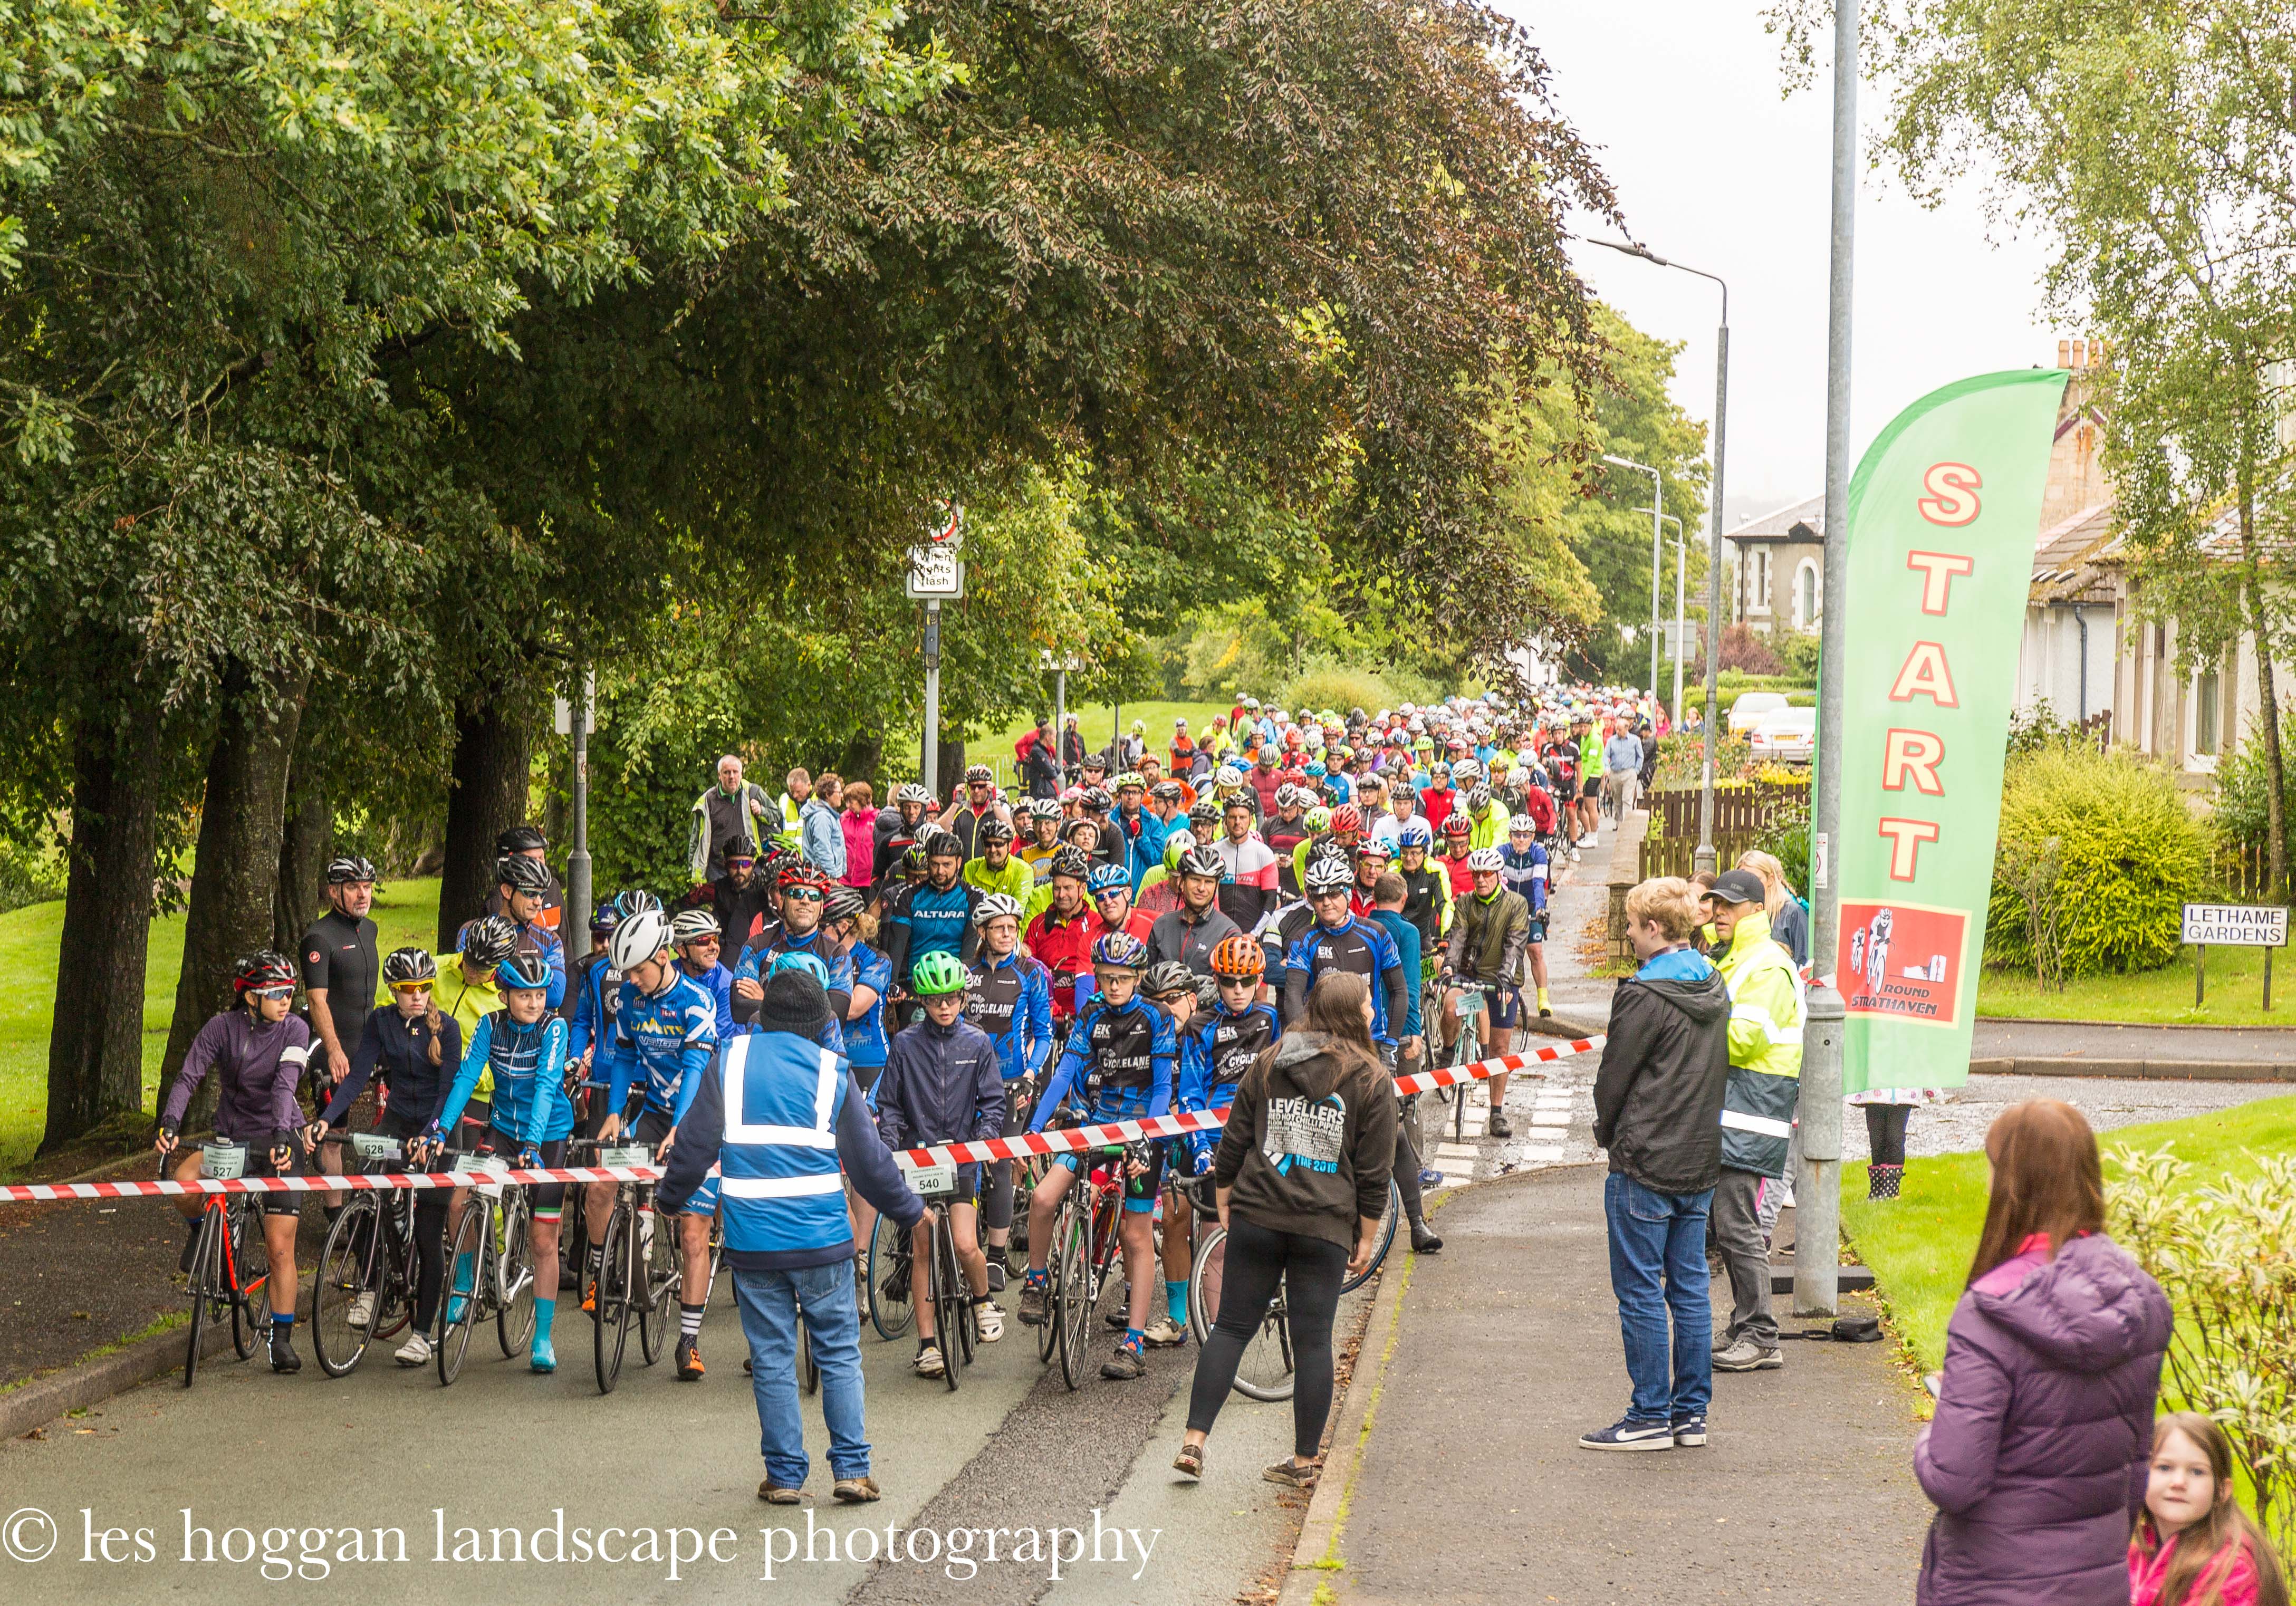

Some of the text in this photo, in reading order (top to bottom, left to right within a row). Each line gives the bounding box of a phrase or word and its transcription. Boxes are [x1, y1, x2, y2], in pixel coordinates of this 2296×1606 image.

[920, 552, 951, 561] When
[1878, 462, 1982, 883] START
[914, 910, 965, 918] ALTURA
[2190, 908, 2282, 925] LETHAME
[2188, 925, 2281, 942] GARDENS
[1318, 946, 1333, 956] EK
[1884, 984, 1930, 998] ROUND
[971, 1003, 1014, 1014] CYCLELANE
[1851, 996, 1937, 1015] STRATHAVEN
[1094, 1024, 1111, 1035] EK
[1217, 1026, 1237, 1040] EK
[1103, 1055, 1150, 1069] CYCLELANE
[1229, 1052, 1259, 1068] CYCLE
[1269, 1098, 1346, 1125] LEVELLERS
[365, 1145, 383, 1156] 528
[1295, 1154, 1338, 1174] TMF 2016
[213, 1166, 232, 1177] 527
[919, 1178, 939, 1190] 540
